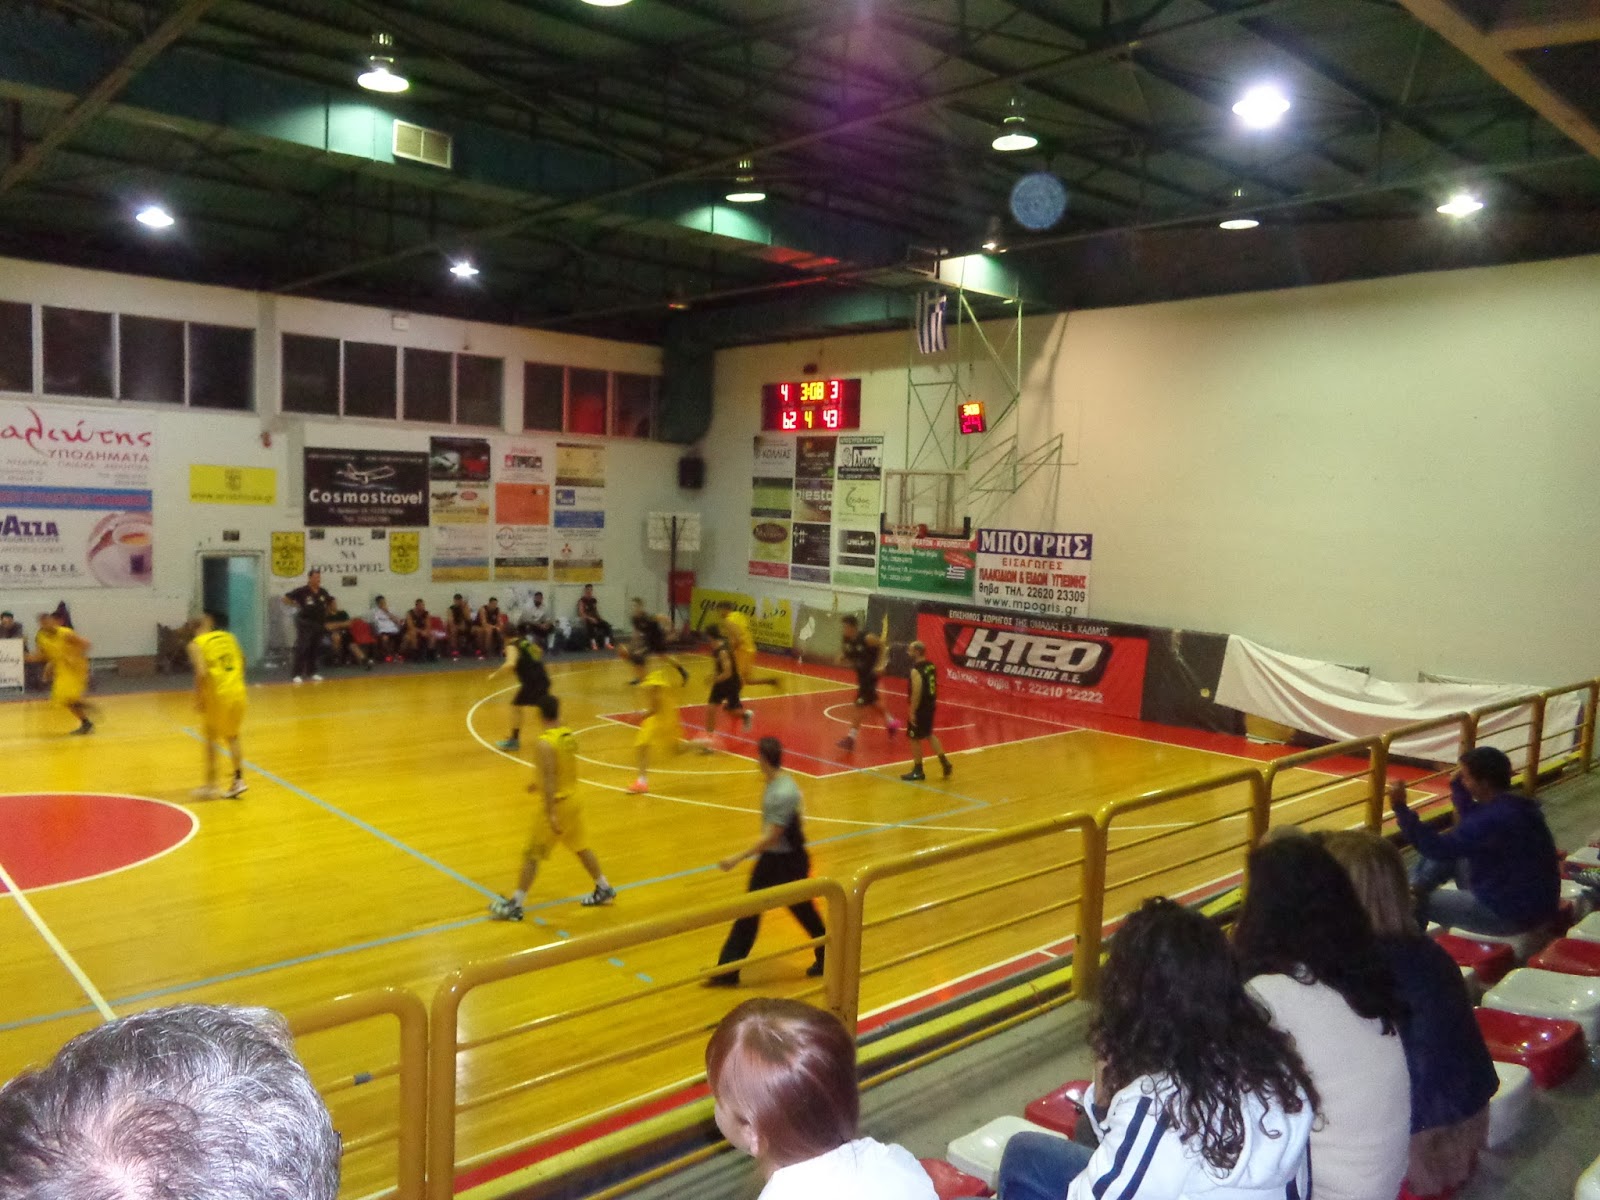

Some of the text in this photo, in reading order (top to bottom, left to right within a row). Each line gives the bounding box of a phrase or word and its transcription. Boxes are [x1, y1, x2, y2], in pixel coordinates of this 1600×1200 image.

[781, 380, 839, 401] 4 3:08 3
[783, 409, 838, 429] 62 4 43
[48, 449, 150, 463] ΥΠΟΔΗΜΑΤΑ
[309, 488, 423, 505] Cosmostravel
[0, 514, 59, 537] AZZA
[334, 536, 364, 546] ΑΡΗΣ
[981, 530, 1088, 558] ΜΠΟΓΡΗΣ
[1002, 557, 1063, 571] ΕΙΣΑΓΩΓΕΣ
[1005, 585, 1024, 597] ΤΗΛ.
[1027, 587, 1054, 600] 22620
[1057, 590, 1085, 603] 23309
[984, 597, 1077, 616] www.mpogris.gr
[983, 614, 1013, 626] ΧΟΡΗΓΟΣ
[966, 628, 1103, 673] ΚΤΕΟ
[1029, 682, 1063, 698] 22210
